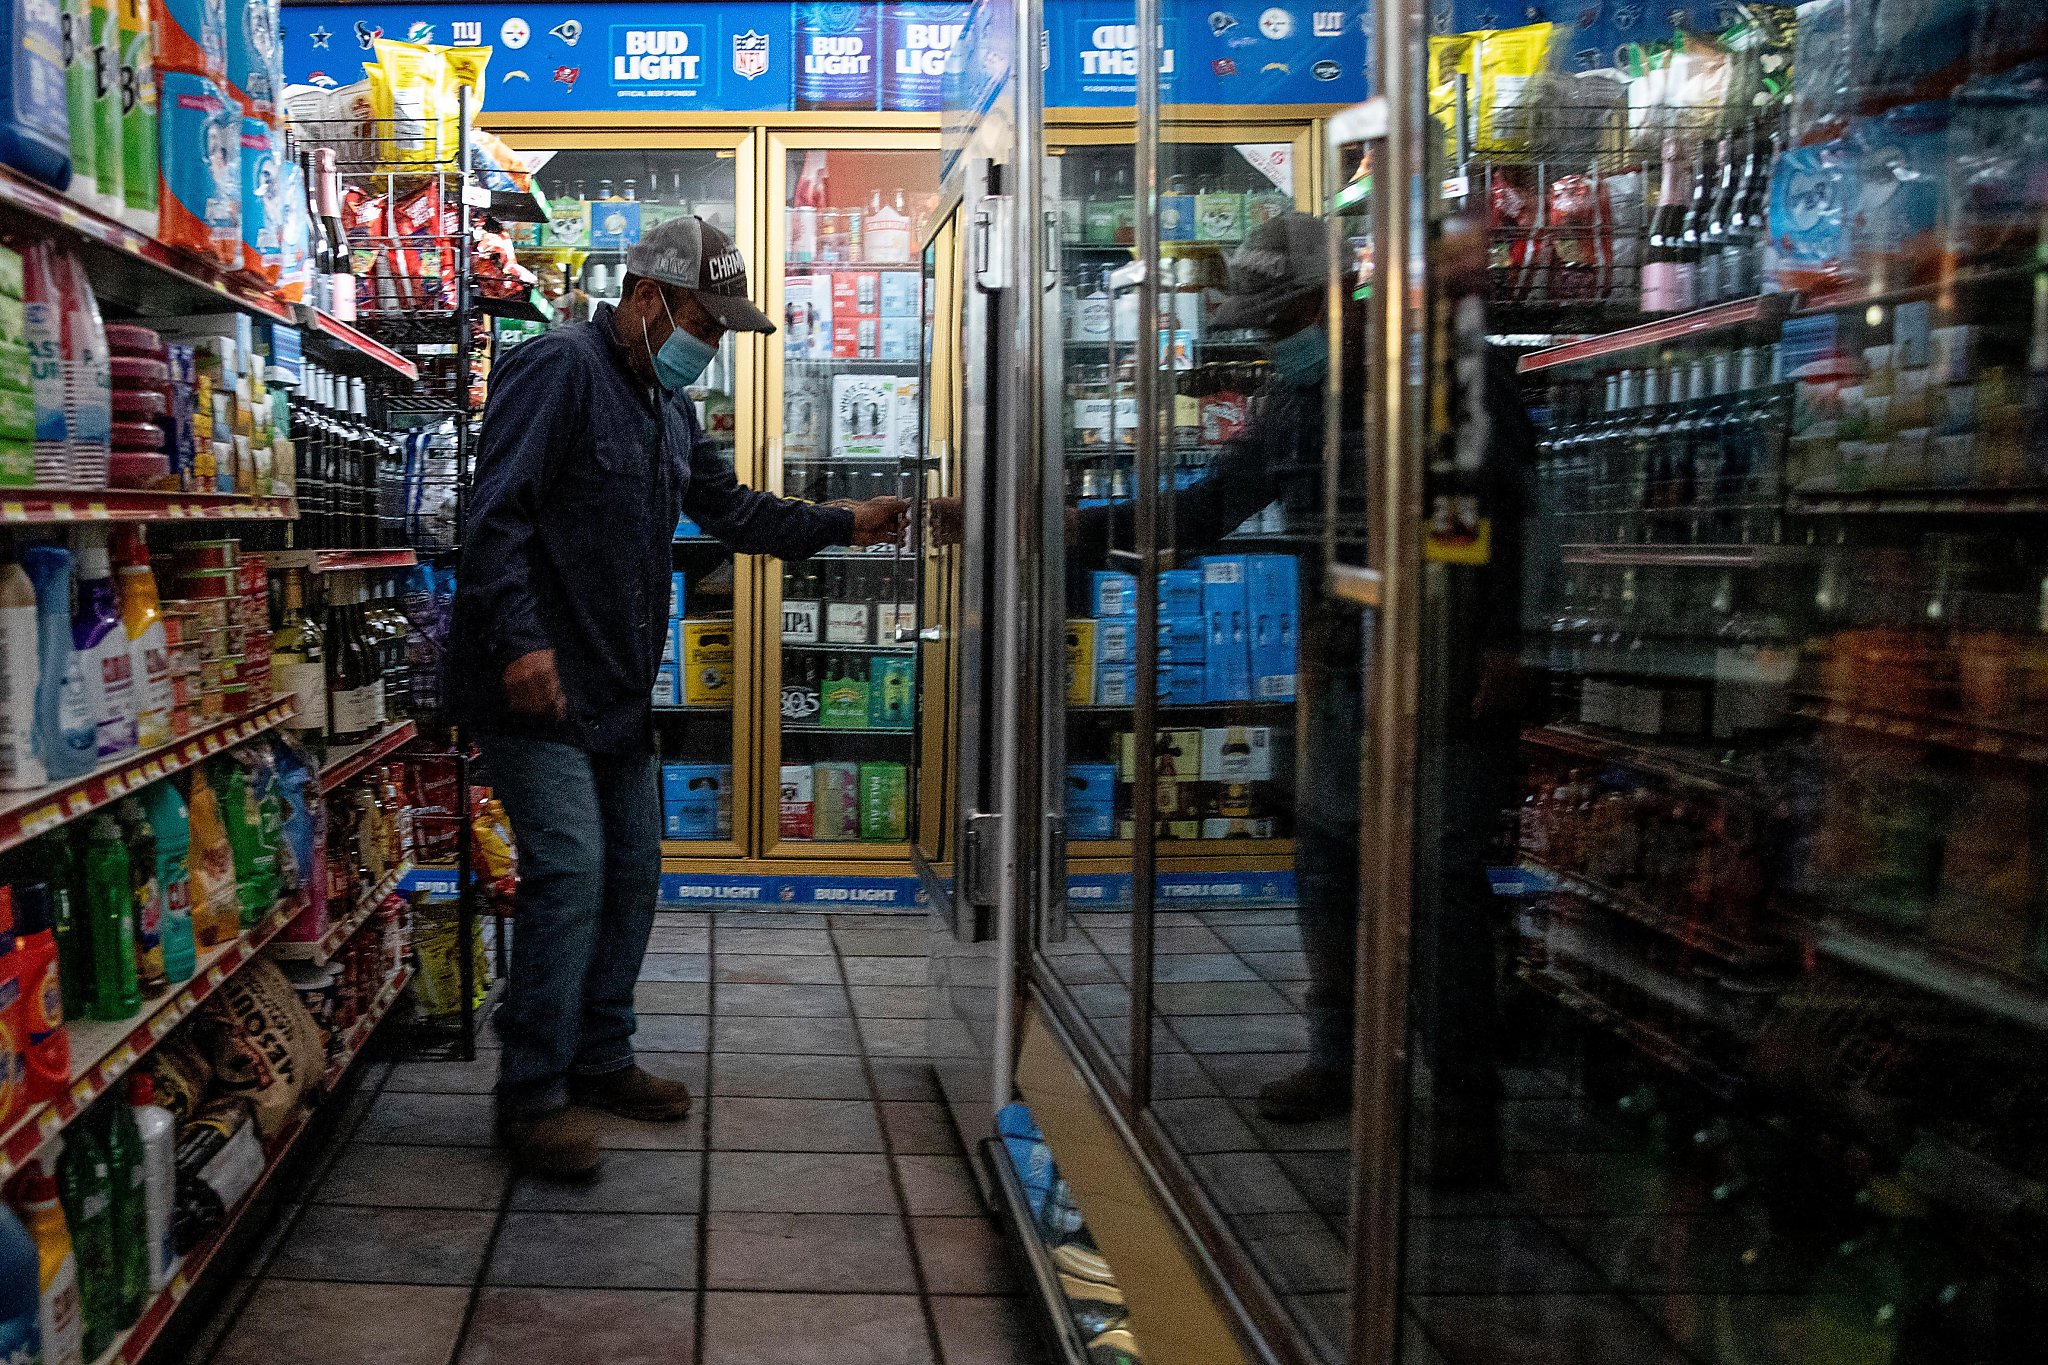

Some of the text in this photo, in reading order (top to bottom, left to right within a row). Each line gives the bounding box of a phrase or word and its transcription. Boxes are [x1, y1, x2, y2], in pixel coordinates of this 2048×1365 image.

[626, 30, 689, 55] BUD
[812, 37, 863, 55] BUD
[614, 55, 701, 80] LIGHT
[804, 55, 872, 75] LIGHT
[783, 612, 813, 632] IPA
[679, 885, 762, 899] BUD LIGHT
[814, 888, 898, 902] BUD LIGHT
[224, 982, 295, 1084] MESQUI
